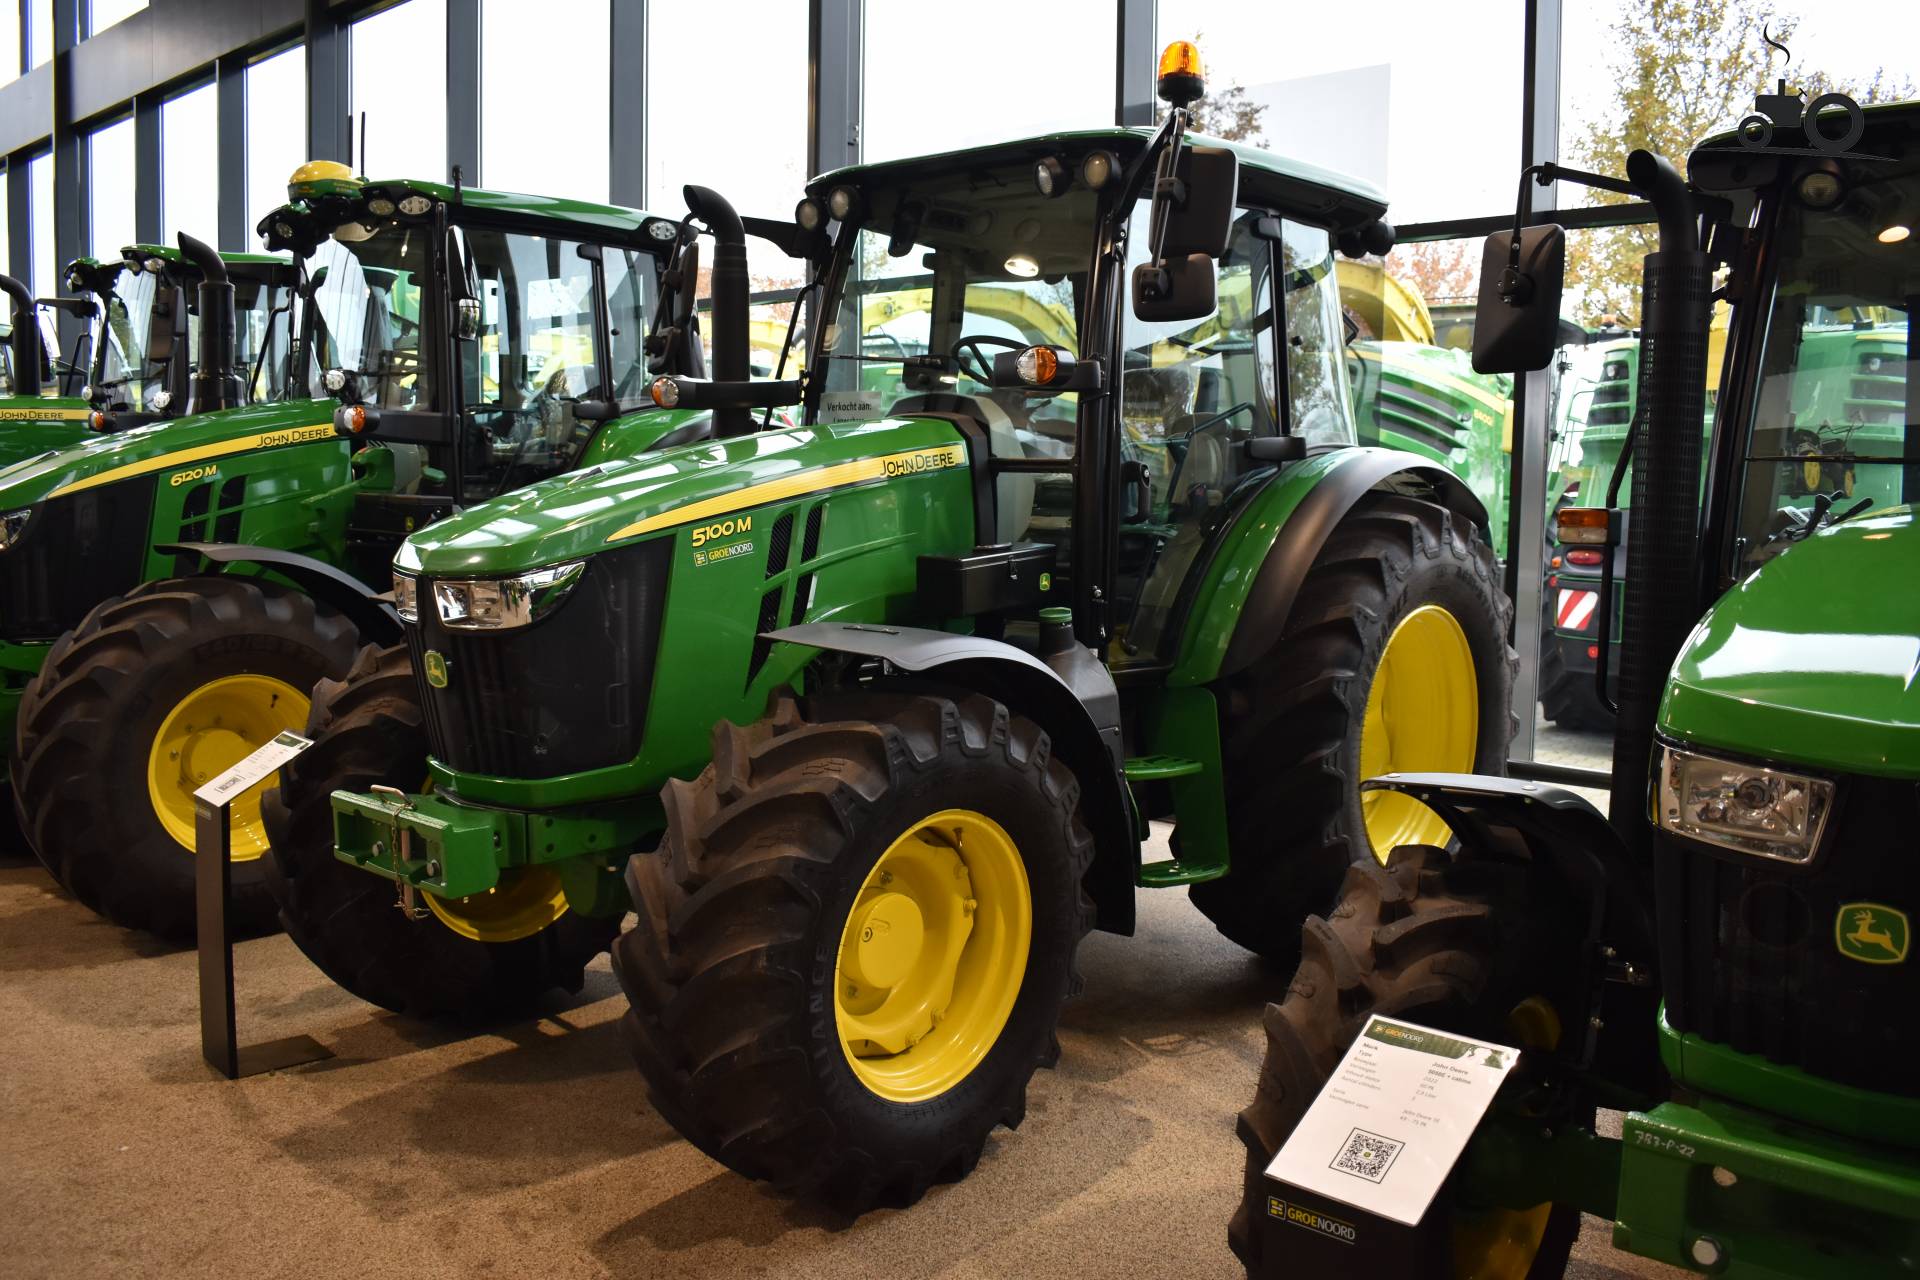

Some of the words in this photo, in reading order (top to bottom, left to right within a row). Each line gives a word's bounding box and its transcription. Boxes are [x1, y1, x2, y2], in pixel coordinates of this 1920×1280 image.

[28, 410, 64, 419] DEERE
[827, 401, 857, 411] Verkocht
[858, 402, 872, 411] aan:
[257, 435, 290, 448] JOHN
[291, 427, 330, 441] DEERE
[880, 458, 914, 477] JOHN
[914, 452, 955, 471] DEERE
[170, 468, 204, 487] 6120
[205, 464, 218, 477] M
[692, 521, 735, 548] 5100
[736, 516, 753, 534] M
[708, 542, 754, 561] GROENOORD
[1433, 1061, 1448, 1069] John
[1450, 1066, 1468, 1074] Deere
[1287, 1207, 1356, 1241] GROENOORD
